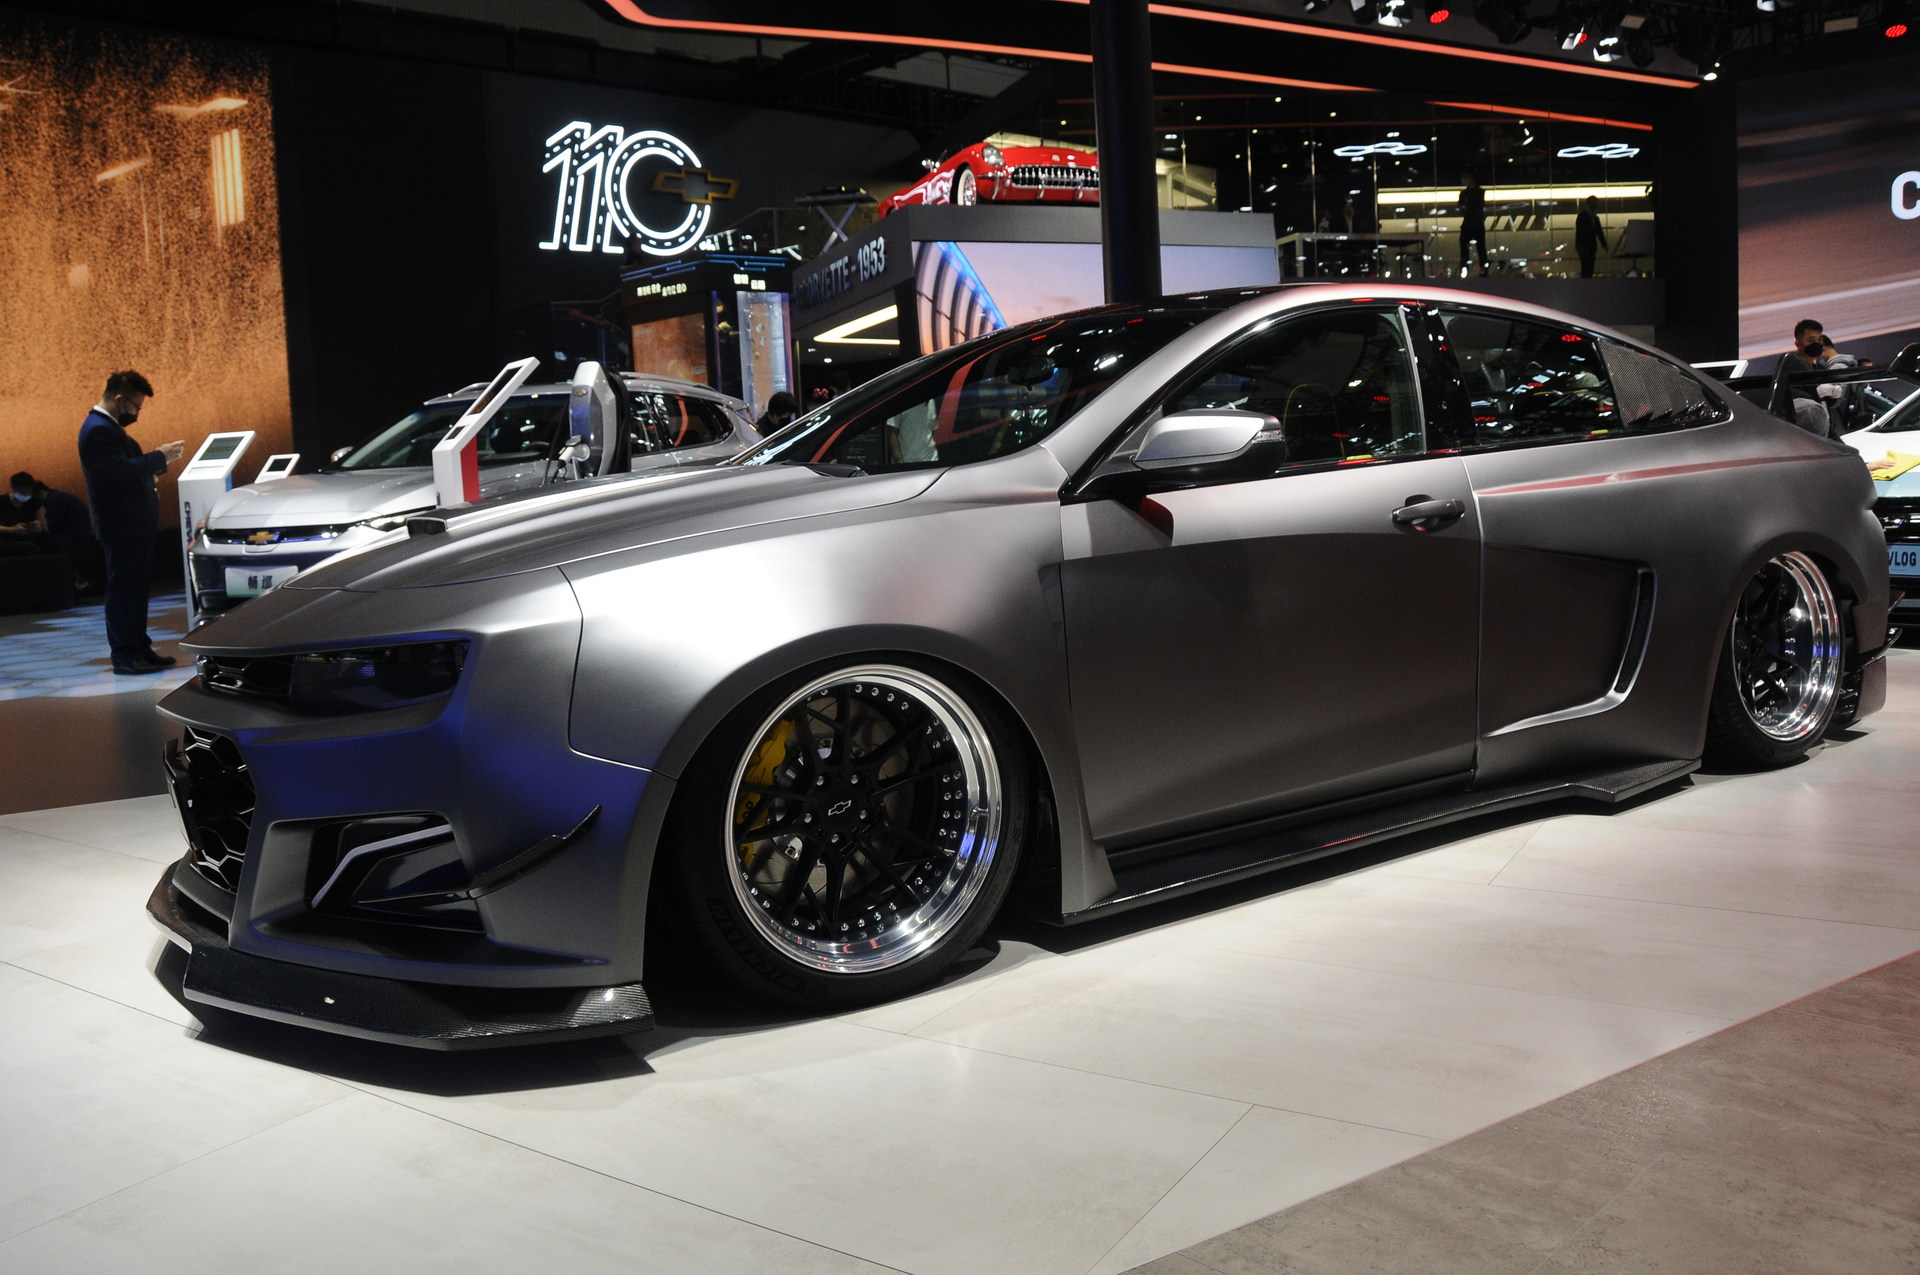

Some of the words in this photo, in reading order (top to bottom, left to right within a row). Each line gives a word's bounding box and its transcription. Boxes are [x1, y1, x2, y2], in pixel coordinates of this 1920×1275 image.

[538, 121, 710, 256] 110
[798, 256, 850, 305] ORVETTE
[1887, 551, 1917, 566] VLOG
